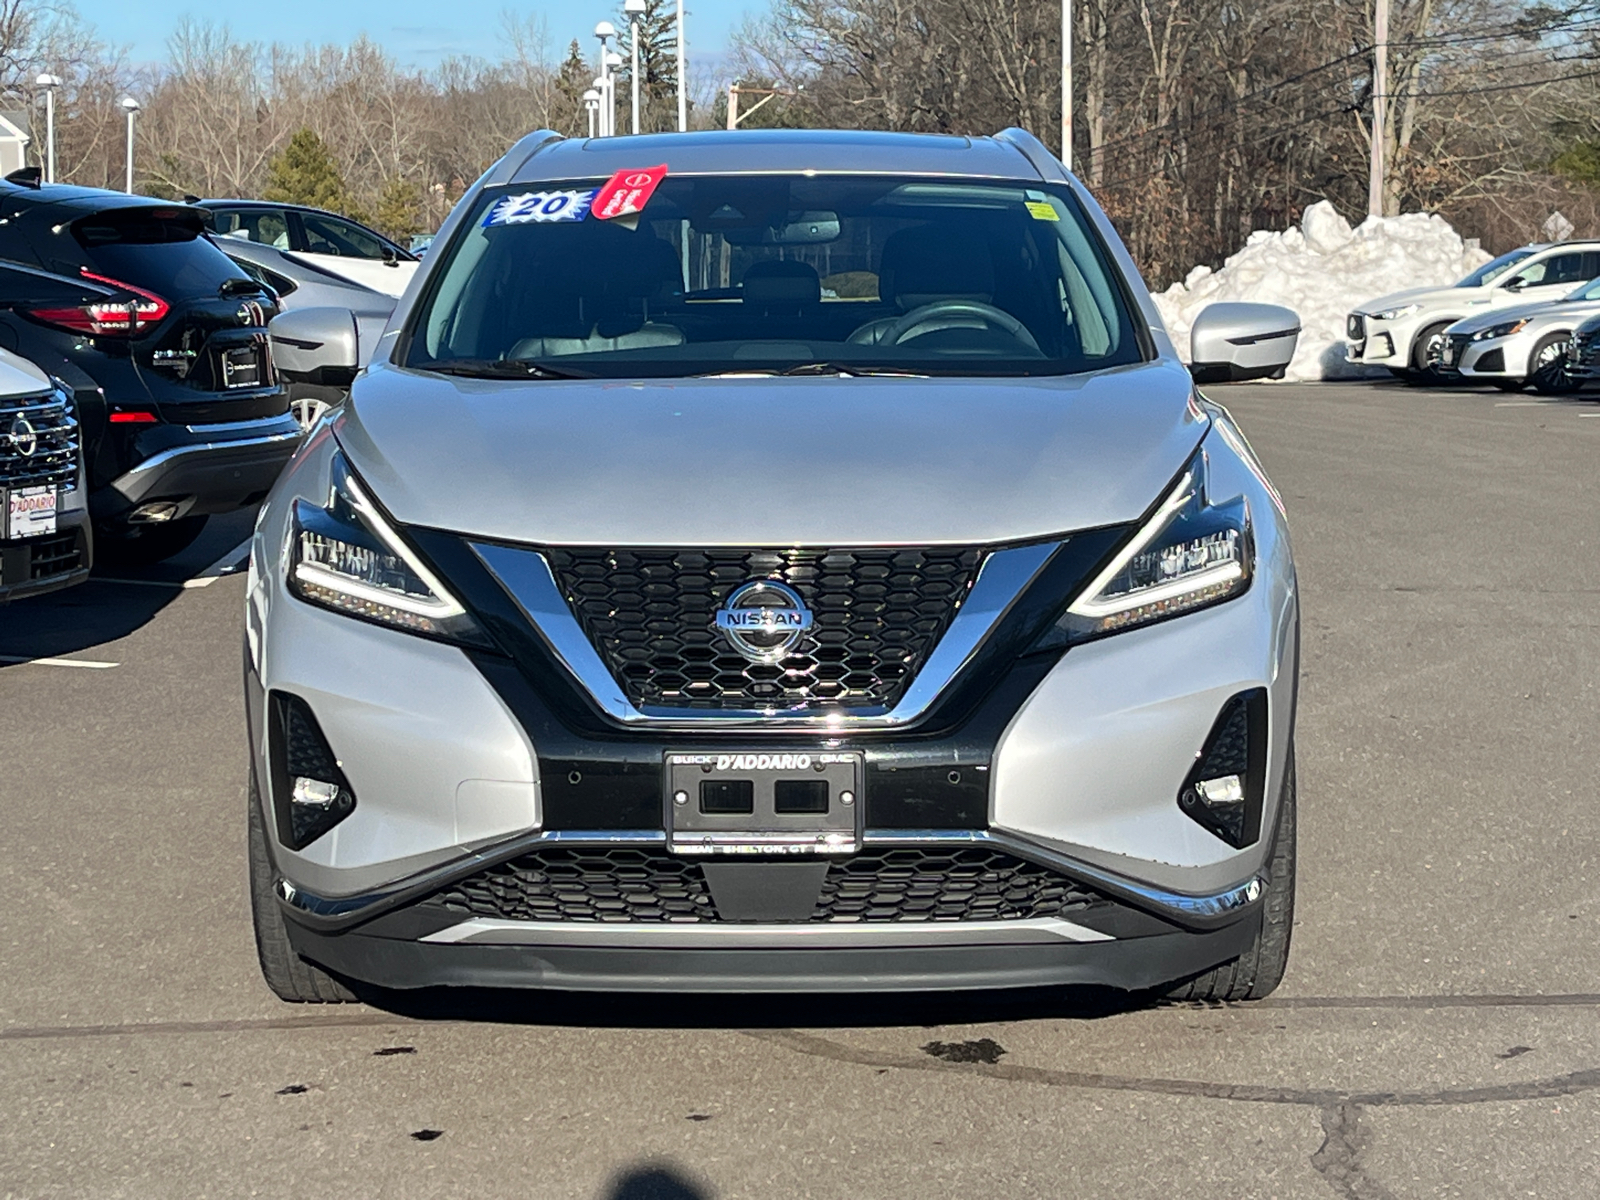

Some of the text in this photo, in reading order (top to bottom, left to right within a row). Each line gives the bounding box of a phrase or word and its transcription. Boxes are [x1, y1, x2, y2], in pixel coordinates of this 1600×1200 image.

[510, 196, 569, 217] 20
[10, 495, 55, 514] D'ADDARIO
[726, 613, 802, 626] NISSAN
[673, 754, 854, 770] BUICK D'ADDARIO GMC
